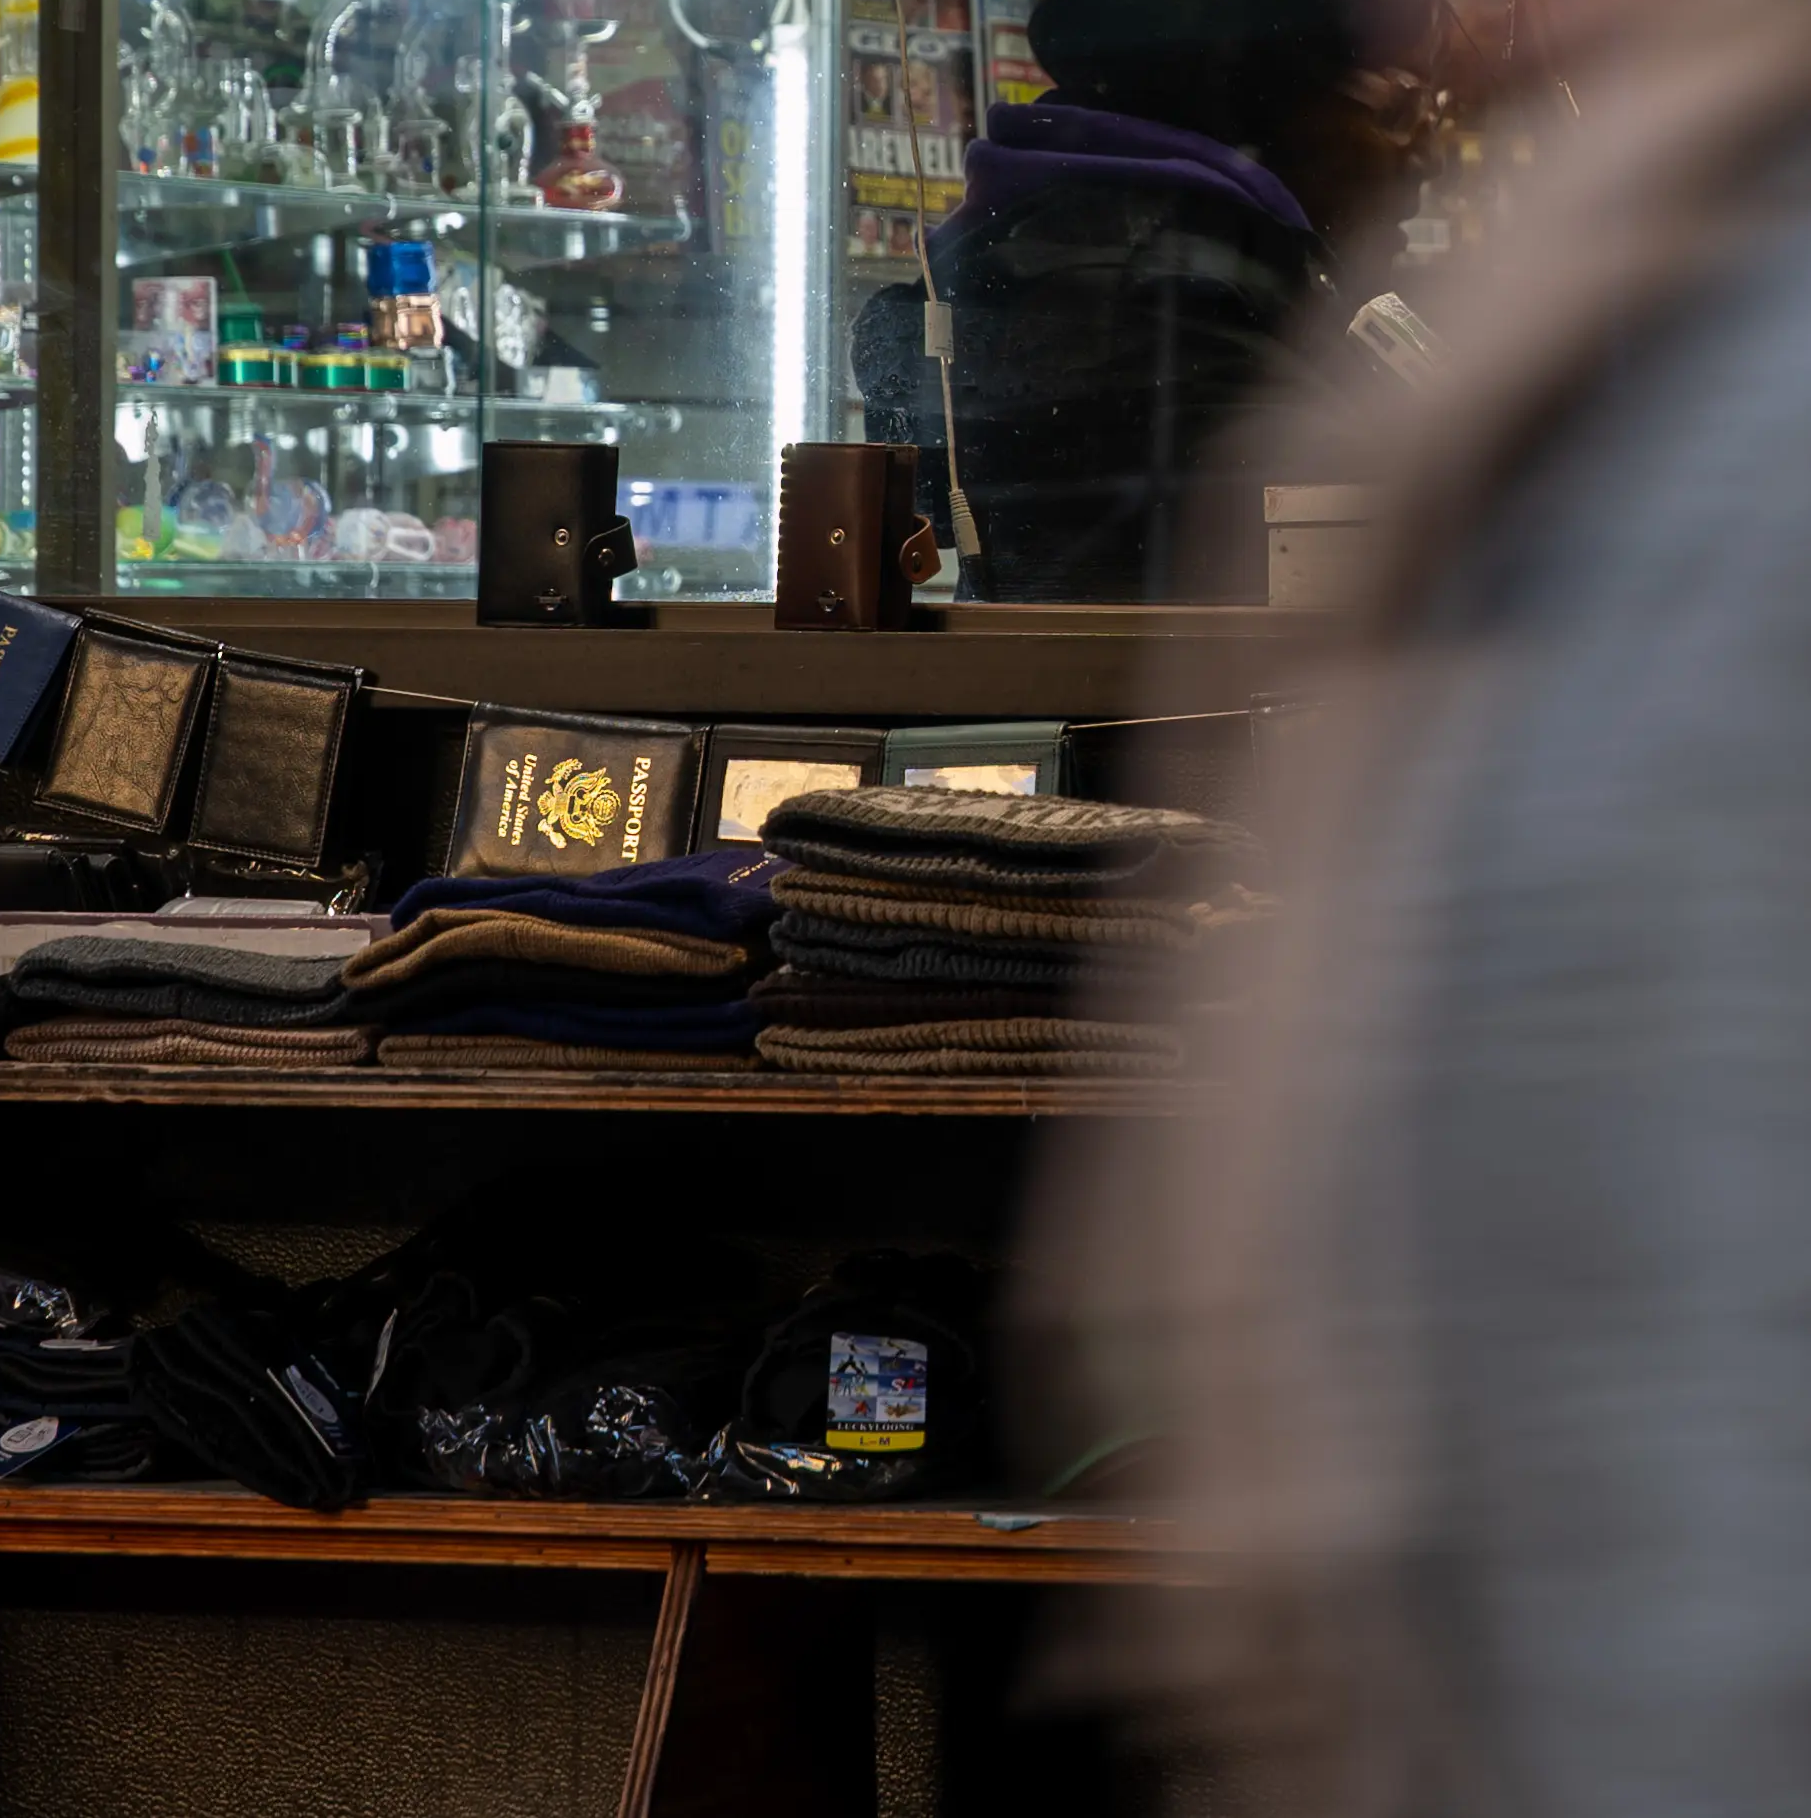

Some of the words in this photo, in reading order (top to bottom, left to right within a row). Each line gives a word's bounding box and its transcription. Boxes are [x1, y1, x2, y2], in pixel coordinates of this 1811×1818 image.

[518, 754, 538, 802] United
[497, 777, 518, 839] America
[510, 802, 530, 847] States
[621, 756, 652, 863] PASSPORT
